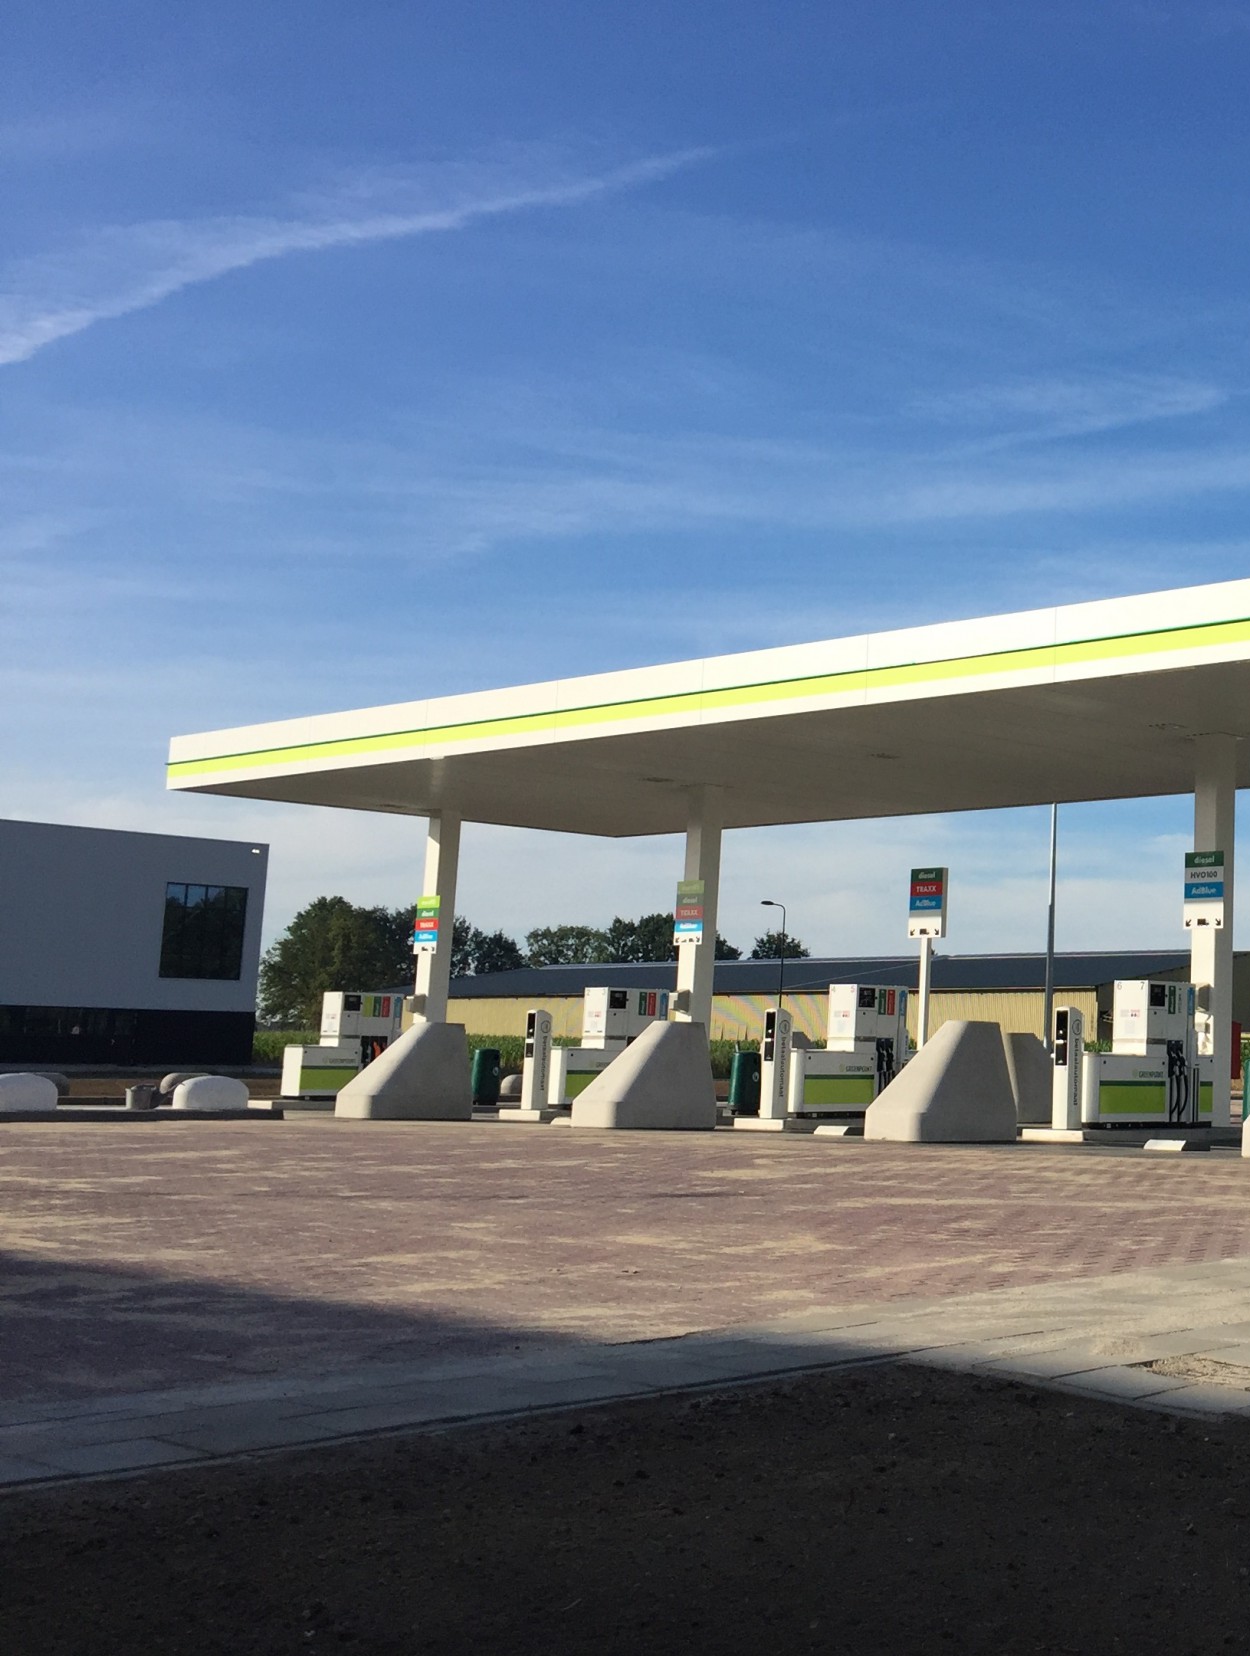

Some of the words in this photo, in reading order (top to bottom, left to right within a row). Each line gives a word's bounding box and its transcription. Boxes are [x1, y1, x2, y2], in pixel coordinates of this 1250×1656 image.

[1194, 855, 1215, 864] diesel
[1116, 981, 1122, 990] 6
[1140, 981, 1145, 990] 7
